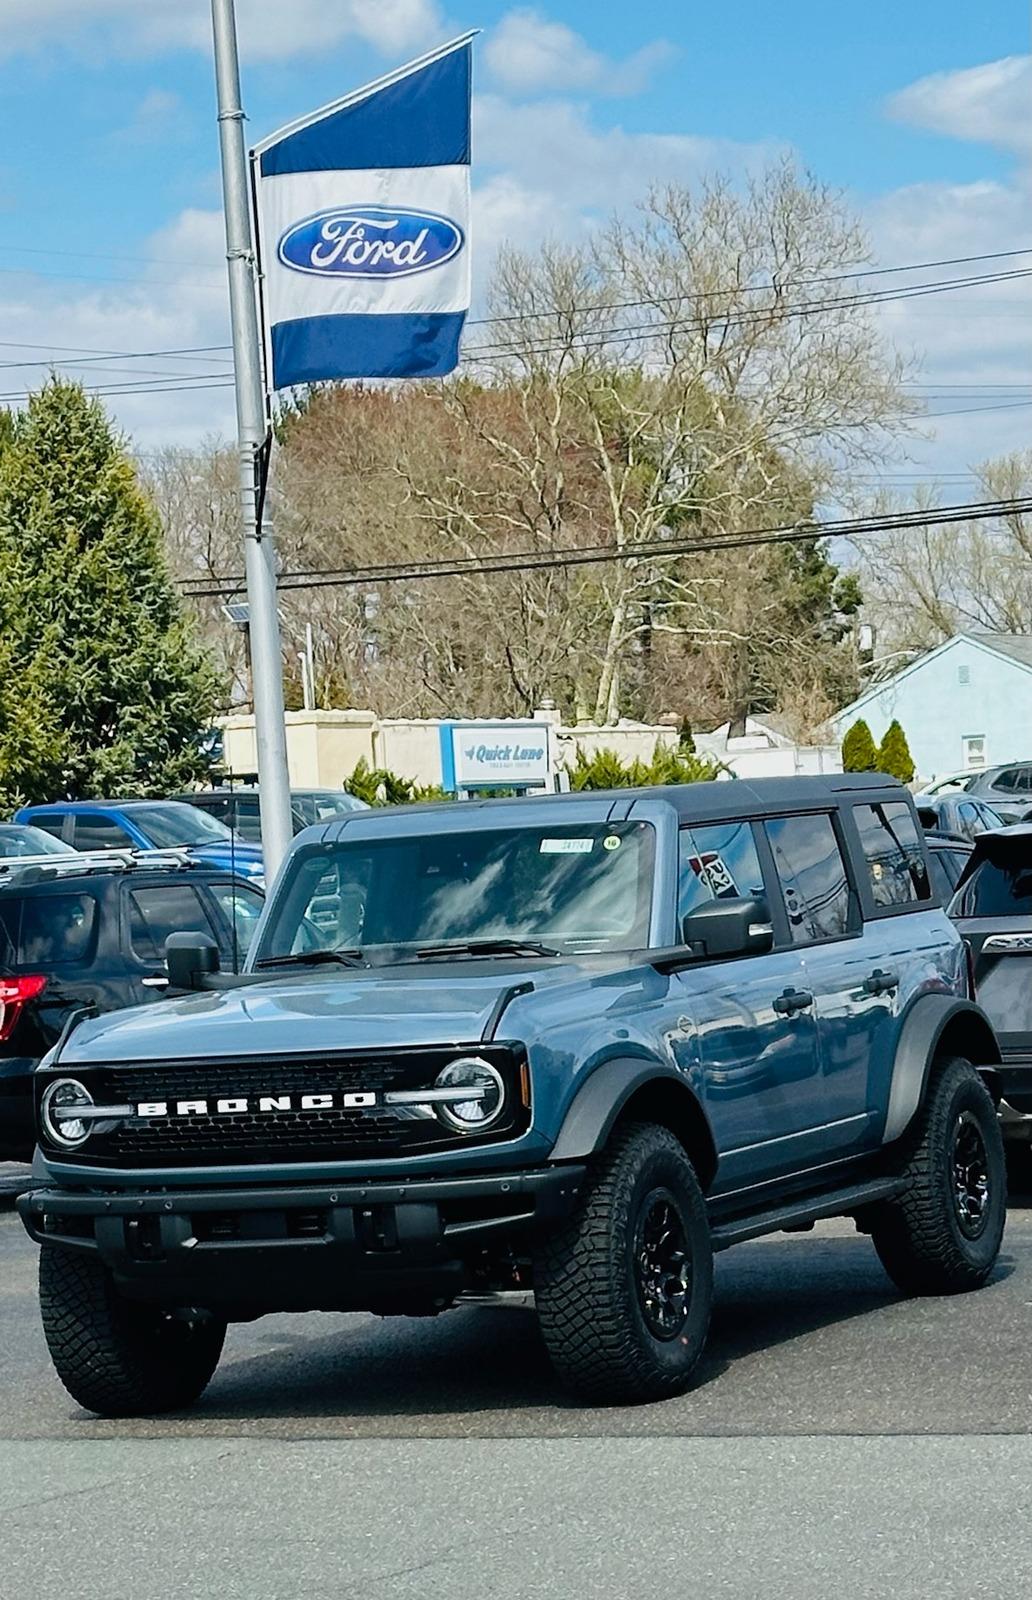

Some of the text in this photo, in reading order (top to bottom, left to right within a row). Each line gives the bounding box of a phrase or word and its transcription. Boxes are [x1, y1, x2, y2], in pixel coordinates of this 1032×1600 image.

[310, 216, 430, 267] Ford
[476, 744, 544, 762] Quick Lane
[137, 1092, 376, 1116] BRONCO
